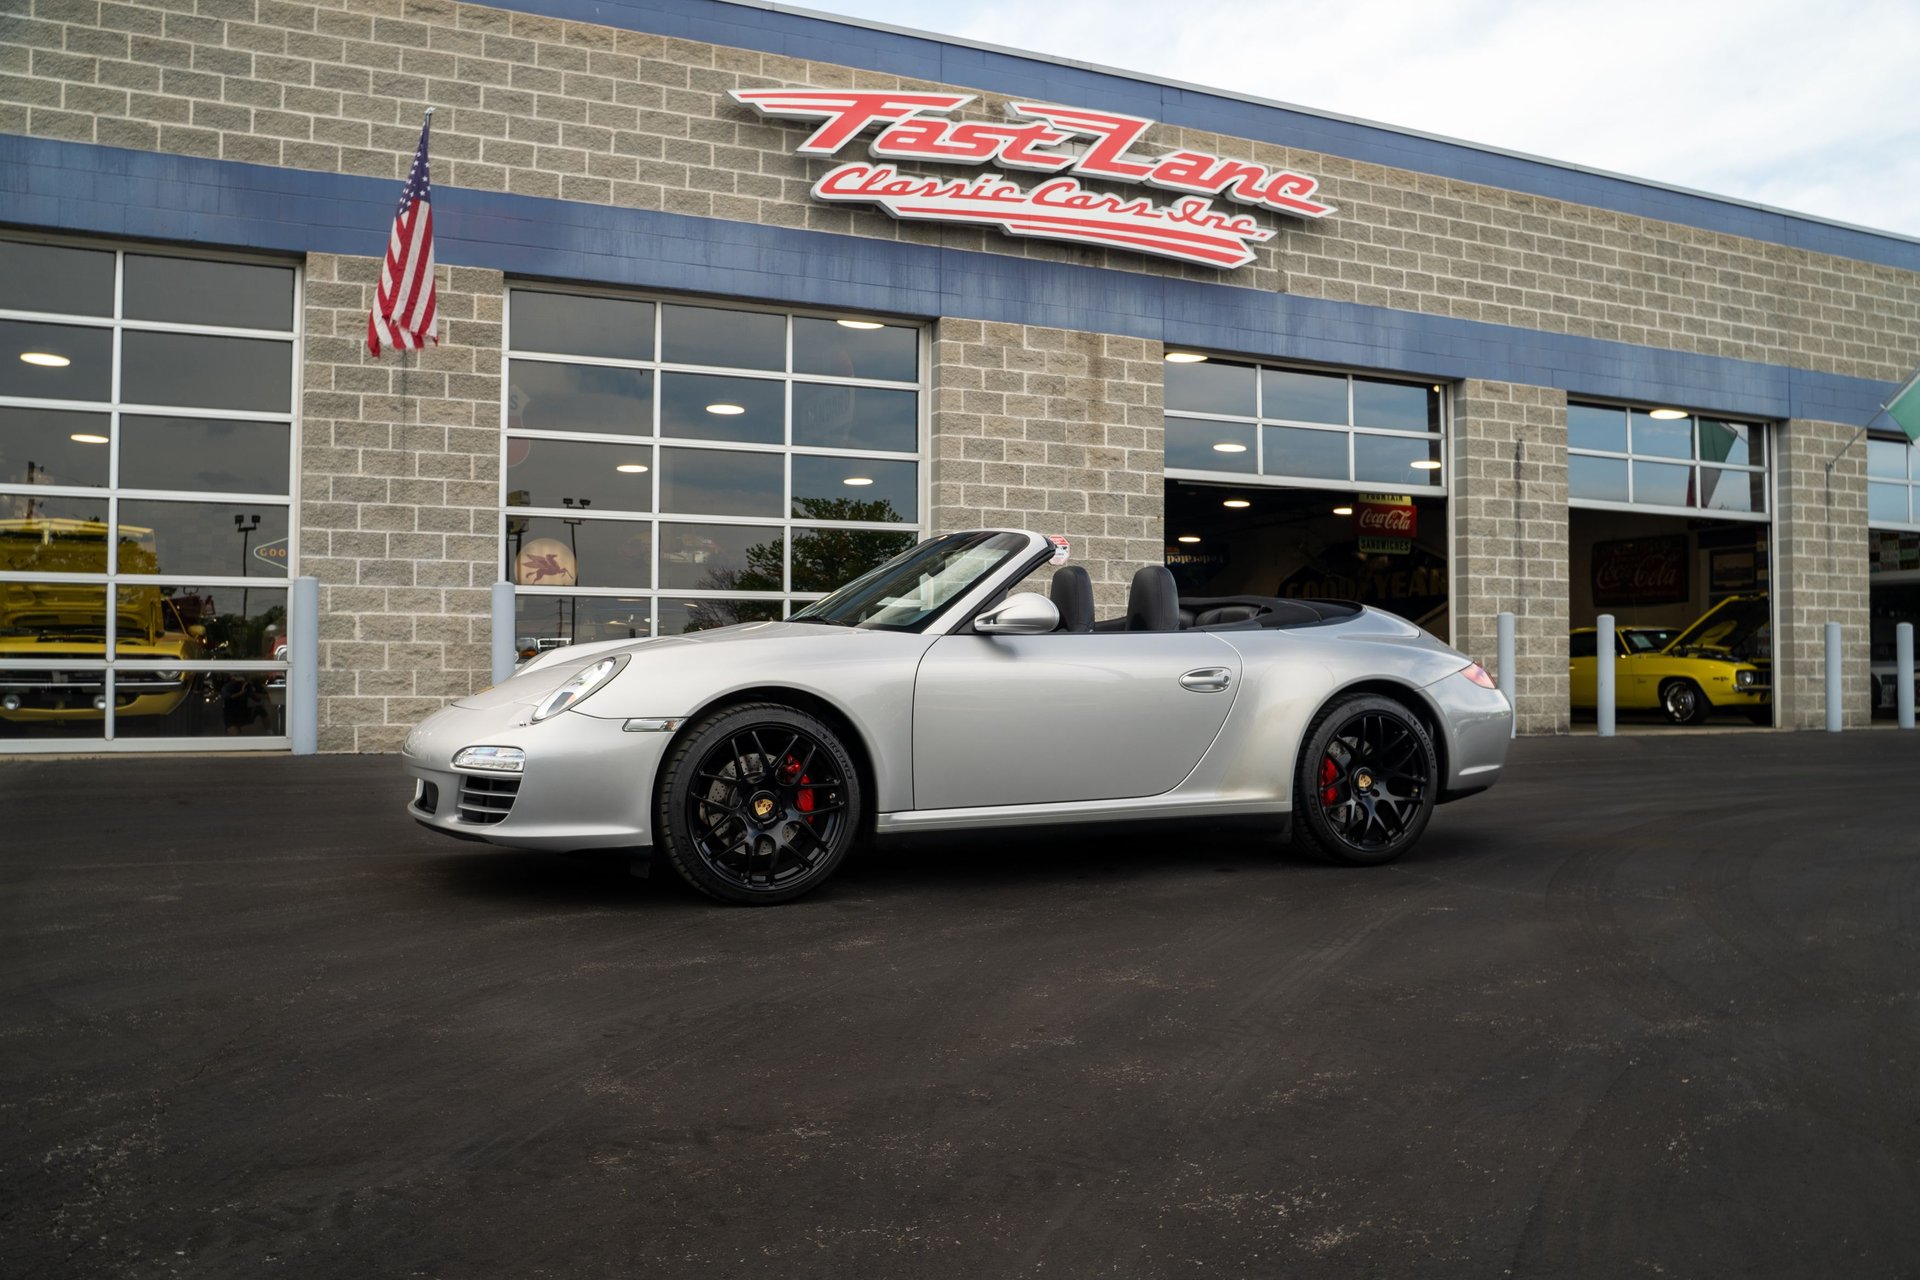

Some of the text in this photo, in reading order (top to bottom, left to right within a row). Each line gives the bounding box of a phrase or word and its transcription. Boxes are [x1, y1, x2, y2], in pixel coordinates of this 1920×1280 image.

[736, 92, 1329, 214] Fast Lane
[820, 167, 1267, 237] Classic Cars Inc.
[1359, 508, 1412, 531] Coca-Cola
[1361, 538, 1410, 551] SANDWICHES
